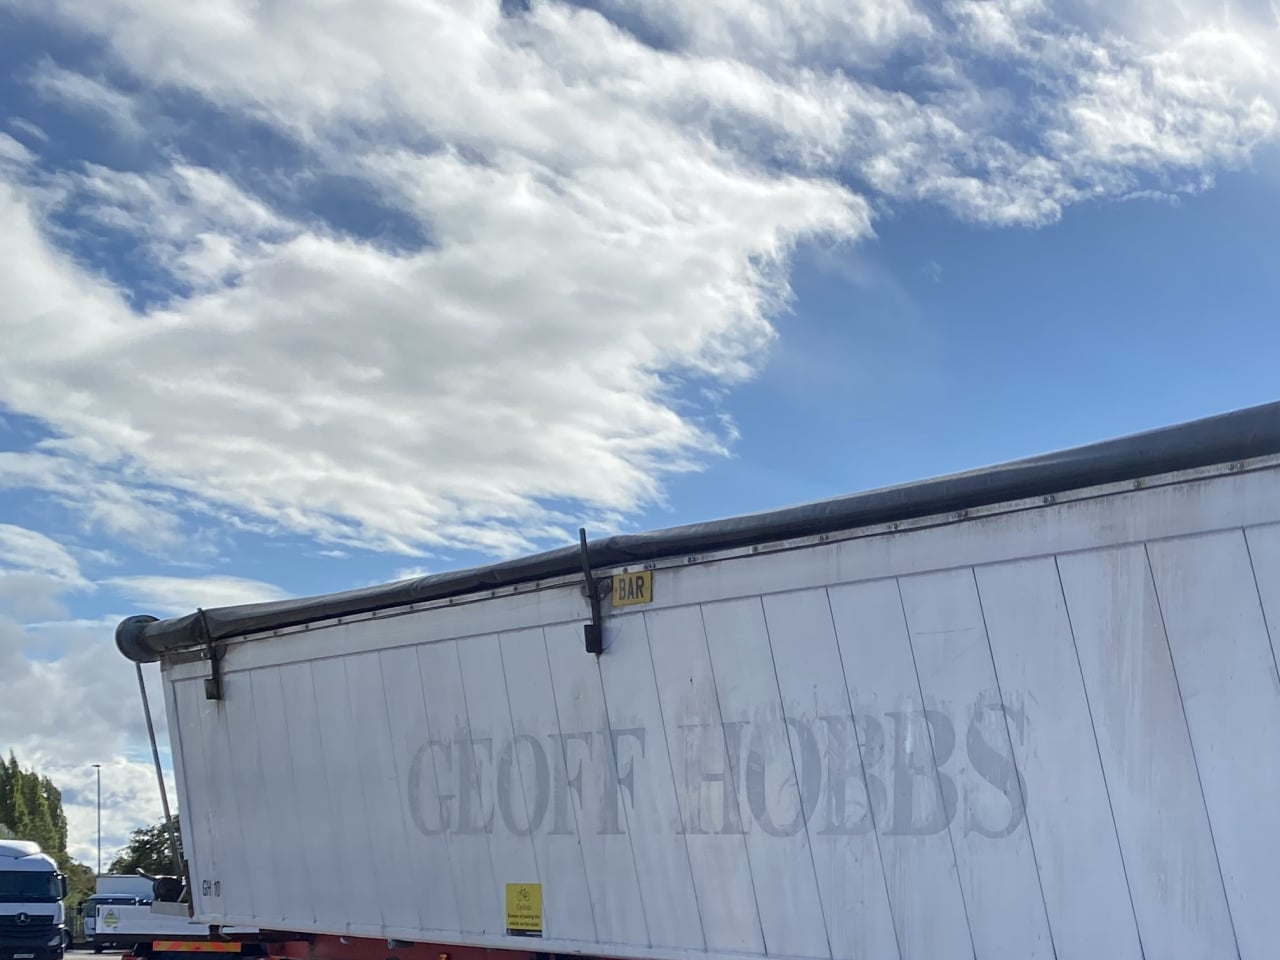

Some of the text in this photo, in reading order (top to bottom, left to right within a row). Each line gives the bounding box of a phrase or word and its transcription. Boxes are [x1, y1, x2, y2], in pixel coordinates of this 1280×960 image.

[618, 575, 645, 601] BAR
[407, 701, 1029, 839] GEOFF HOBBS
